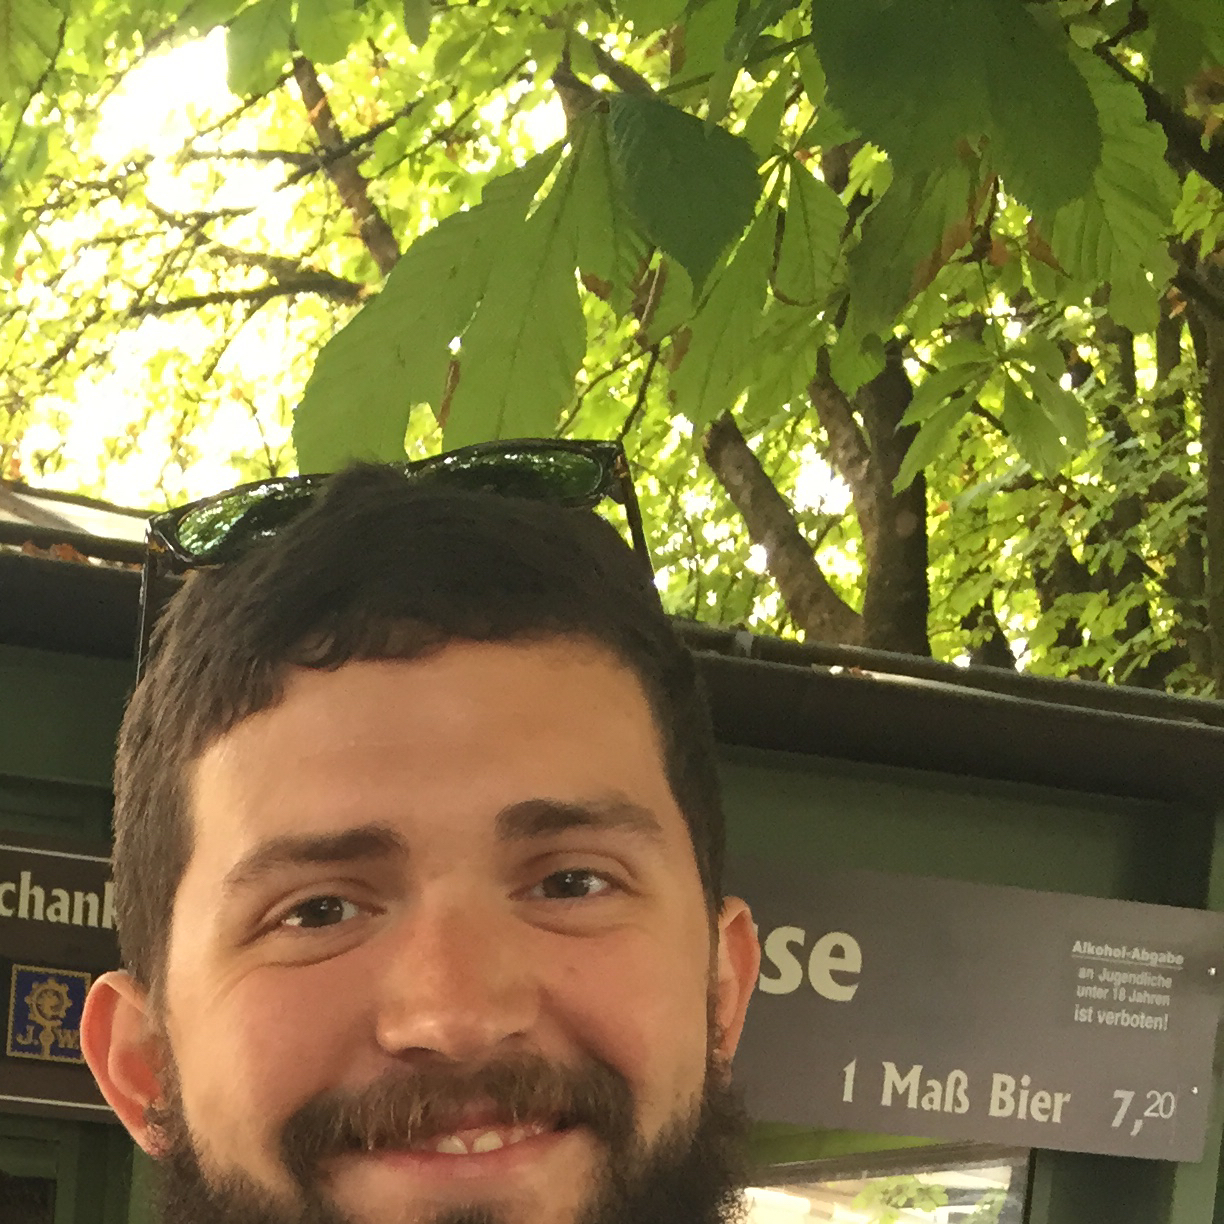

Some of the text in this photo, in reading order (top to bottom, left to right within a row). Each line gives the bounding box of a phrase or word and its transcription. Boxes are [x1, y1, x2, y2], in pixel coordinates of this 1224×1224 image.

[753, 922, 862, 1002] se
[1072, 940, 1184, 966] Alkohol-Abgabe
[1078, 967, 1173, 989] an Jugendliche
[1076, 985, 1171, 1006] unter 18 Jahren
[1074, 1003, 1169, 1032] ist verboten!
[842, 1058, 1176, 1137] 1 Maß Bier 7,20
